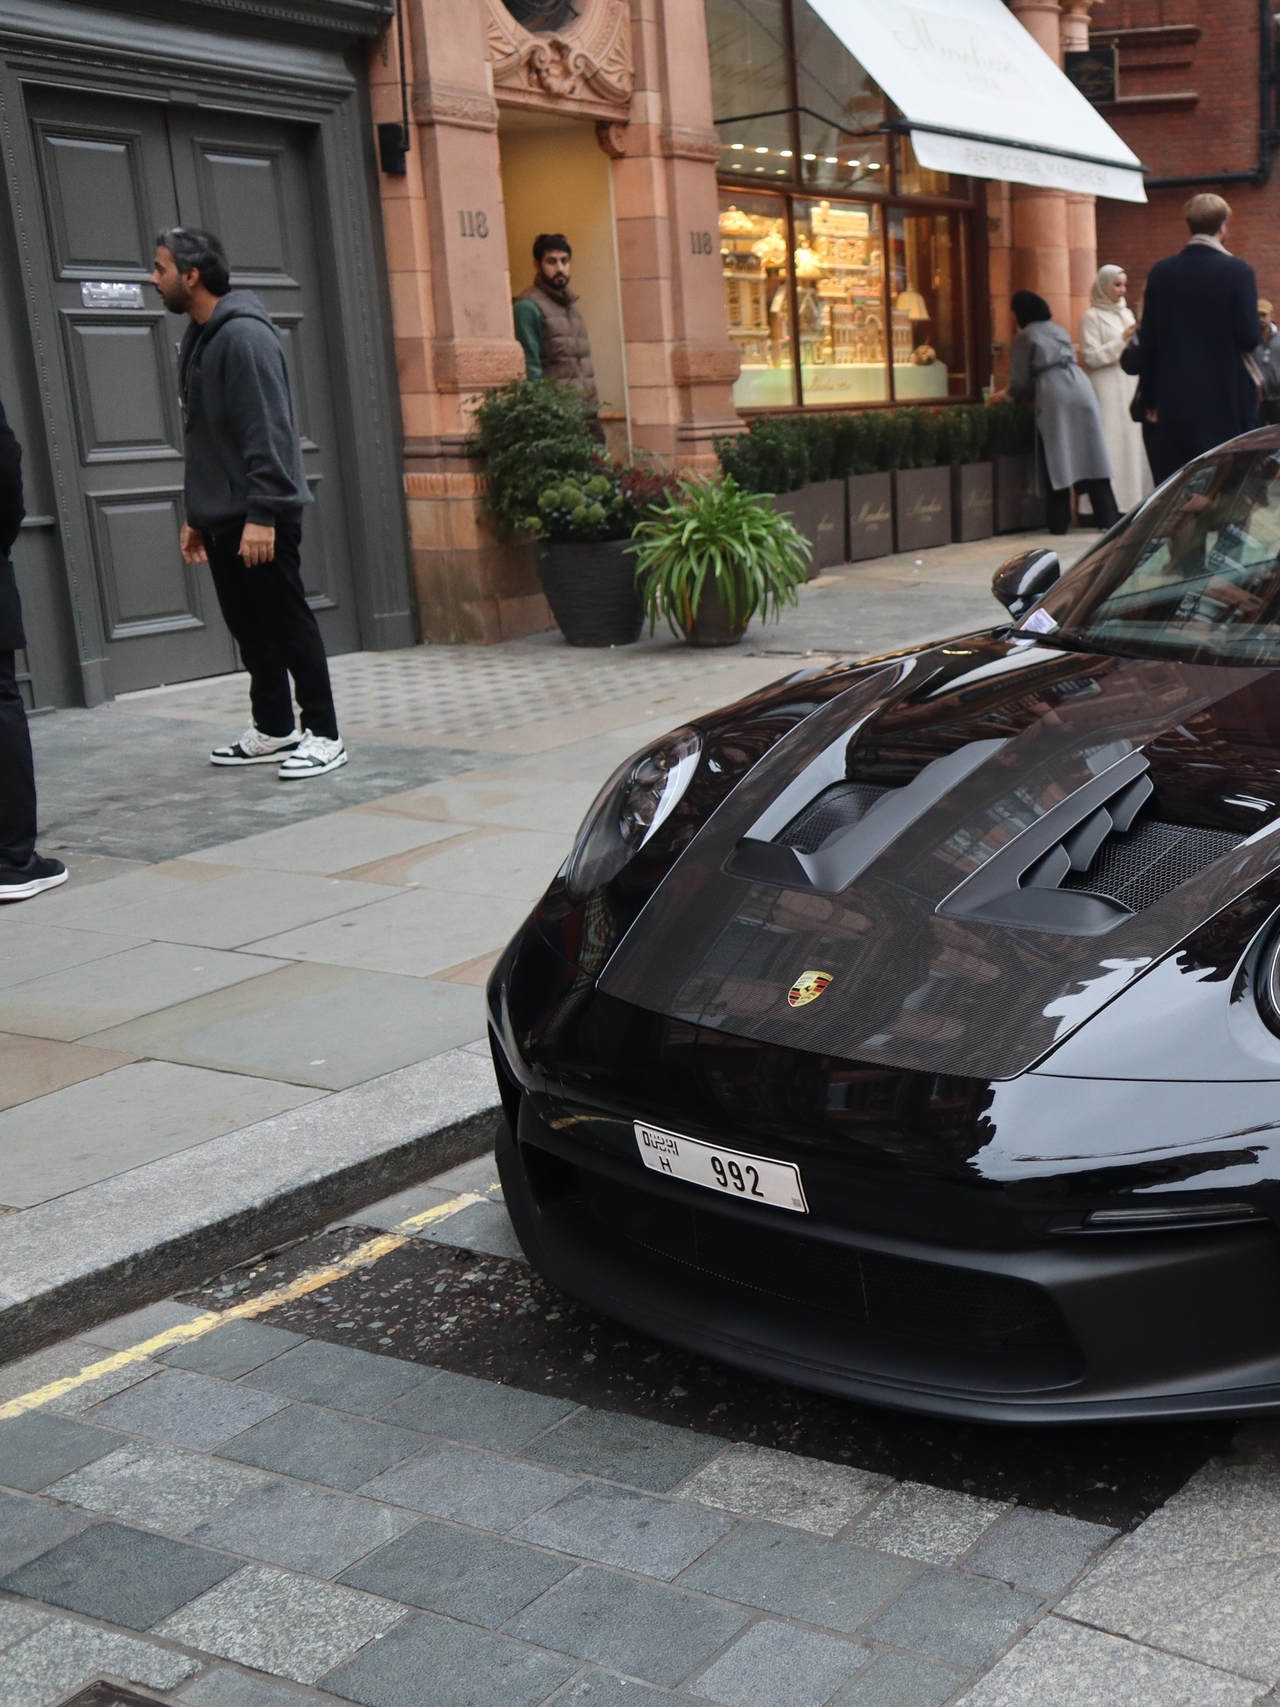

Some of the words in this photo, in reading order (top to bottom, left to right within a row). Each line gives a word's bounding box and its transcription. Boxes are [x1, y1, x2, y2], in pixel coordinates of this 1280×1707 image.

[458, 209, 490, 239] 118
[689, 230, 714, 256] 118
[659, 1155, 674, 1174] H
[711, 1155, 765, 1198] 992
